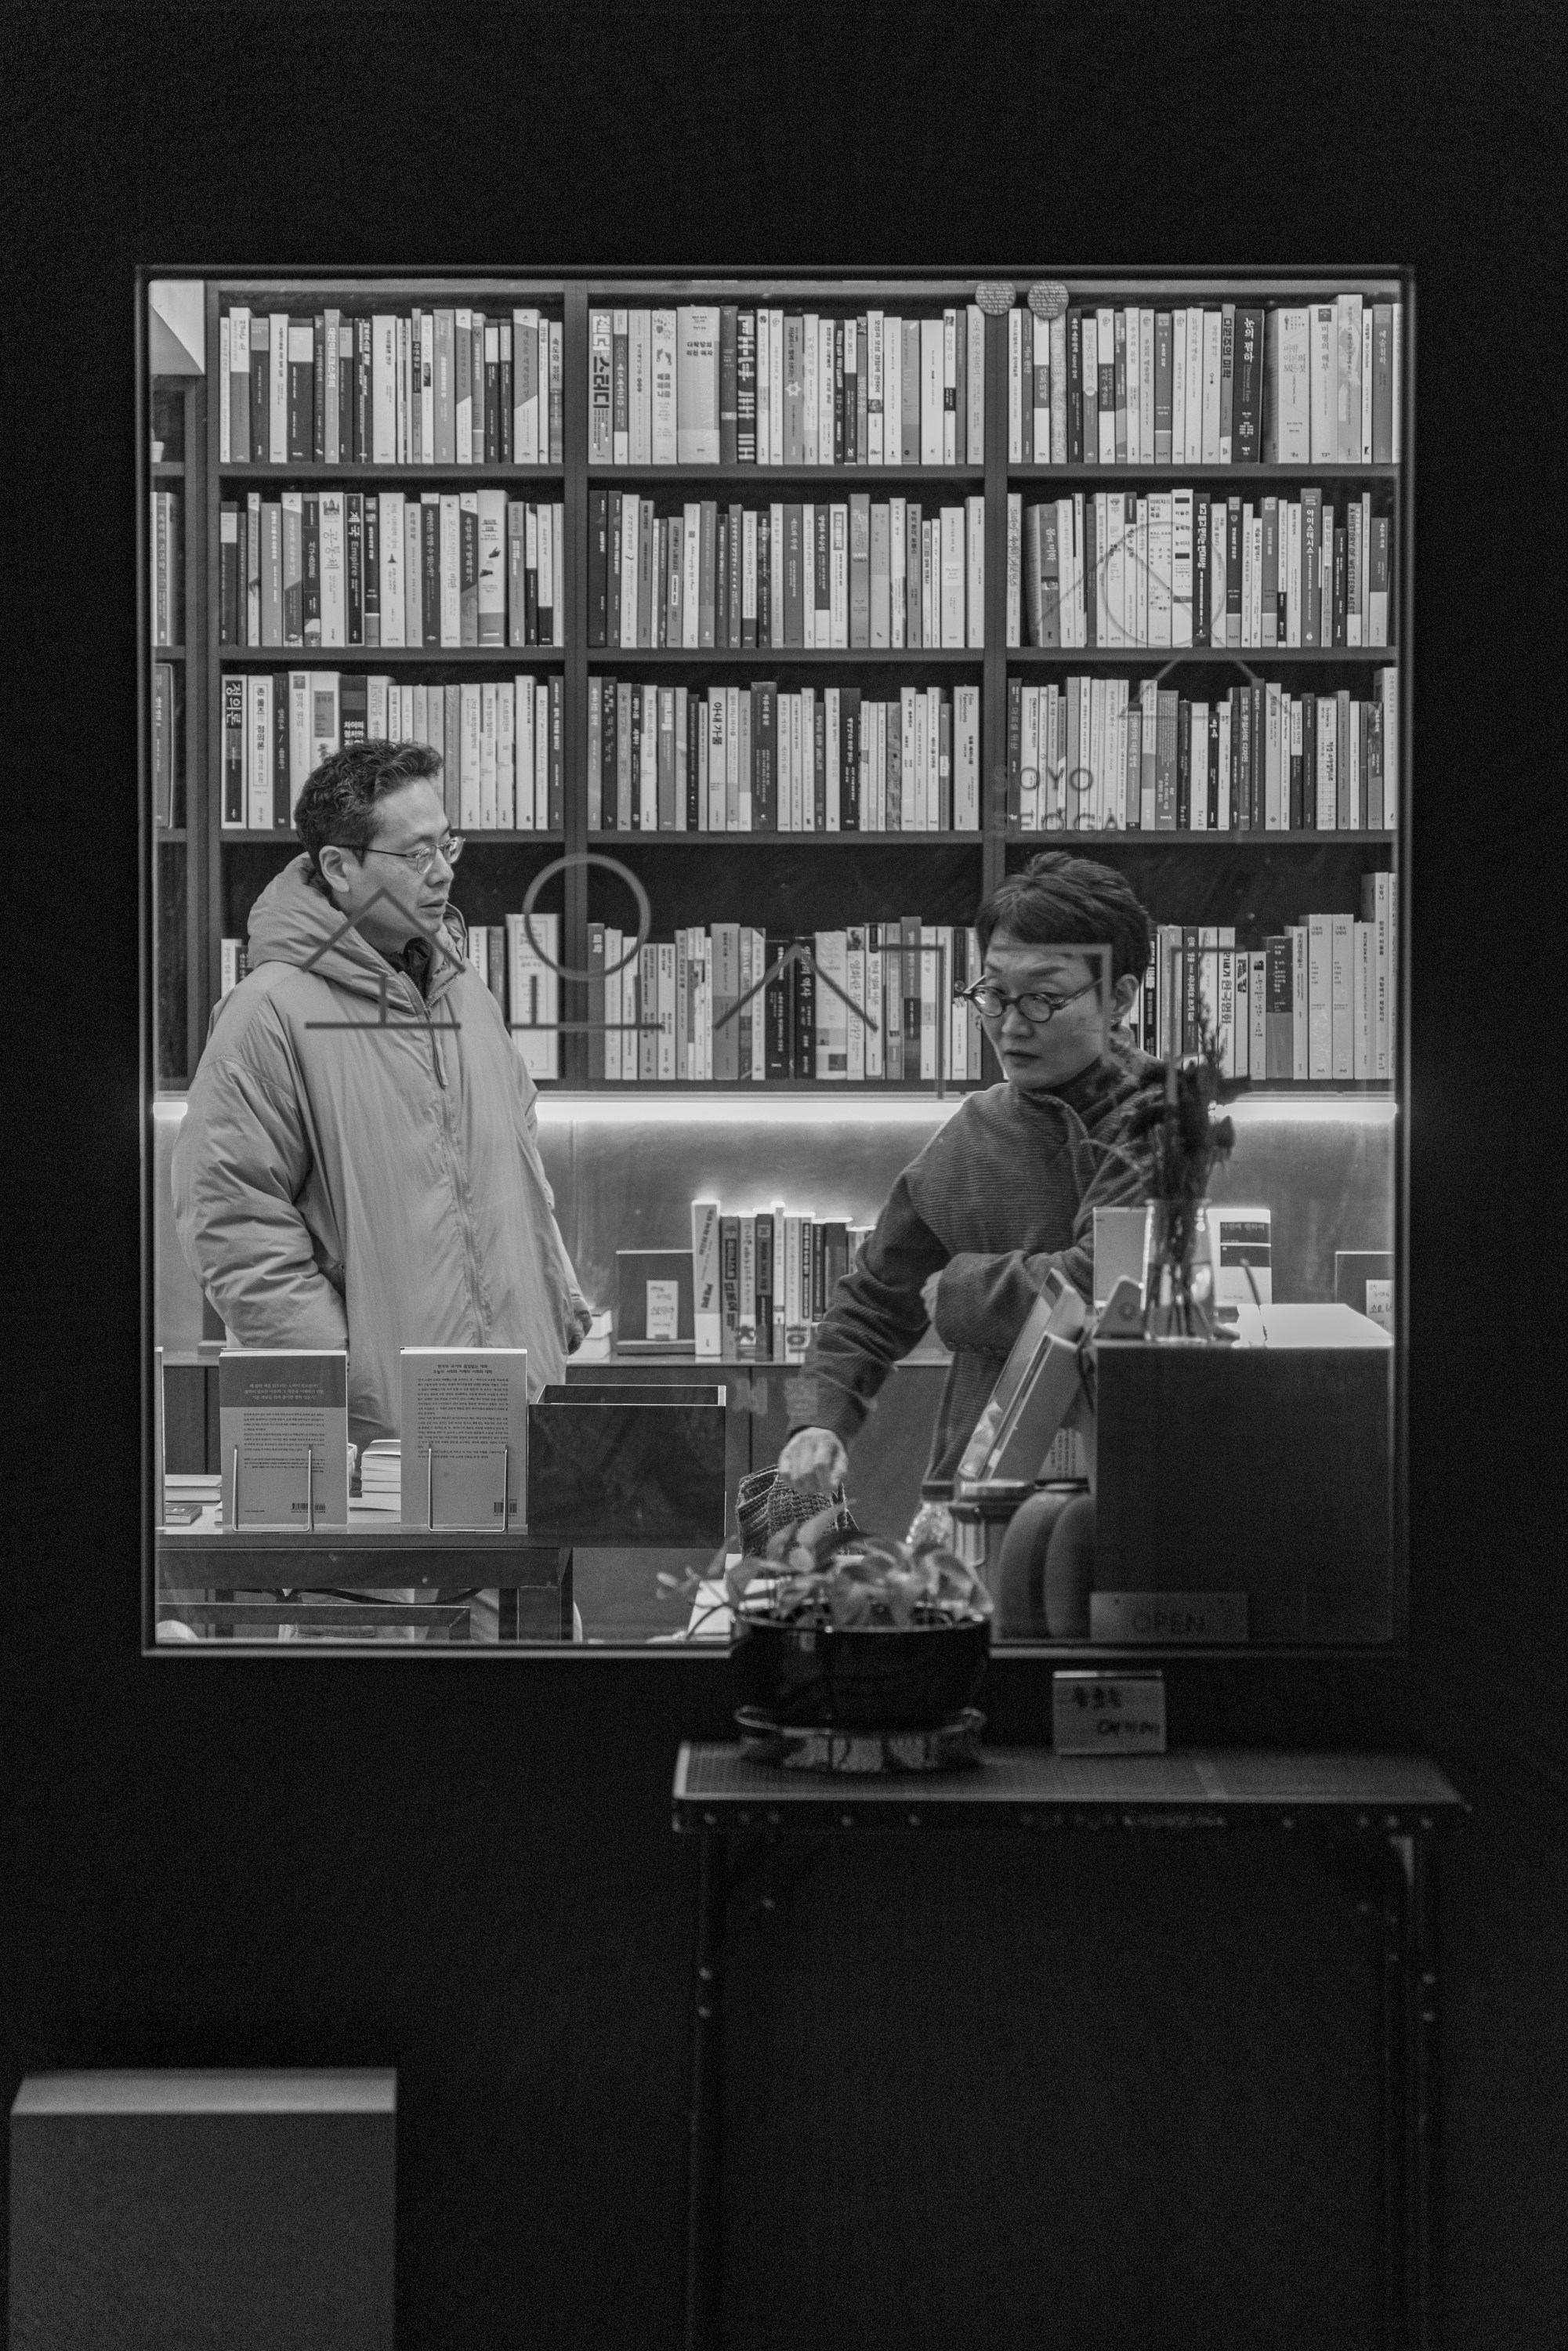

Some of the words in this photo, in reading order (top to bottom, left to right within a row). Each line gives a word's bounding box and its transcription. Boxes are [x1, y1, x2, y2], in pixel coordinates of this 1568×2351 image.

[592, 315, 610, 351] 젠더
[1222, 317, 1233, 356] 다원주의
[1222, 359, 1233, 379] 미학
[592, 356, 610, 409] 스터디
[1198, 503, 1208, 516] 보고
[1198, 516, 1208, 528] 듣고
[348, 512, 361, 538] 제국
[1198, 528, 1208, 545] 만지는
[1305, 509, 1314, 553] 아이스테시스
[323, 528, 341, 570] 공동체
[349, 541, 360, 577] Empire
[1198, 545, 1208, 570] 현대사상
[1348, 548, 1356, 557] OF
[226, 682, 242, 726] 정의론
[369, 683, 378, 717] JUSTICE
[1068, 683, 1080, 712] Frida
[712, 701, 723, 723] 아내
[712, 724, 723, 745] 가뭄
[1241, 741, 1250, 763] 디자인
[992, 765, 1094, 792] SOYO
[801, 978, 813, 998] 역사
[849, 961, 861, 990] 영화란
[1187, 974, 1196, 998] 시나리오
[1187, 998, 1196, 1011] 쓰기
[1221, 980, 1233, 1024] 한국영화
